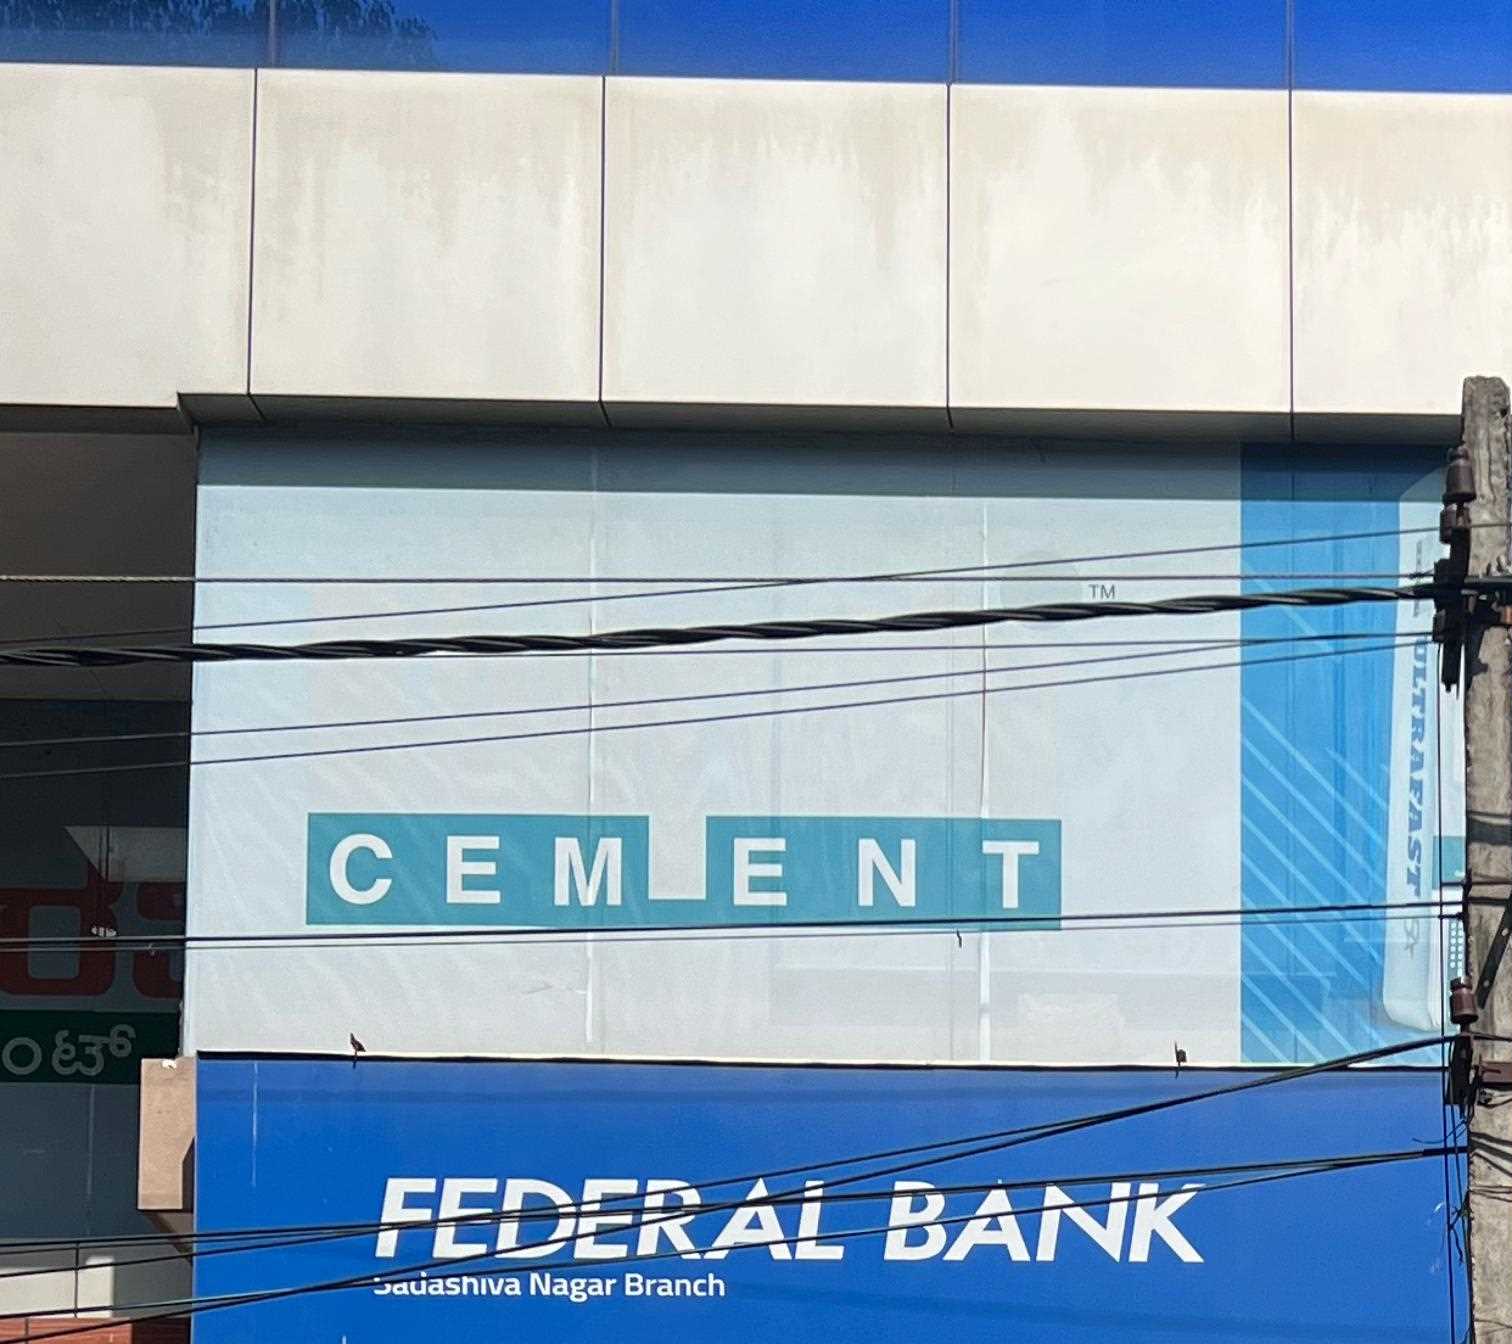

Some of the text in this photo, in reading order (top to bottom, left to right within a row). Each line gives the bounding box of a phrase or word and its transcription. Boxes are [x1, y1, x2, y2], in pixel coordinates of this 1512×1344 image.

[328, 832, 1042, 909] CEMENT
[373, 1176, 1206, 1264] FEDERAL BANK
[530, 1272, 617, 1302] Nagar
[624, 1273, 726, 1298] Branch
